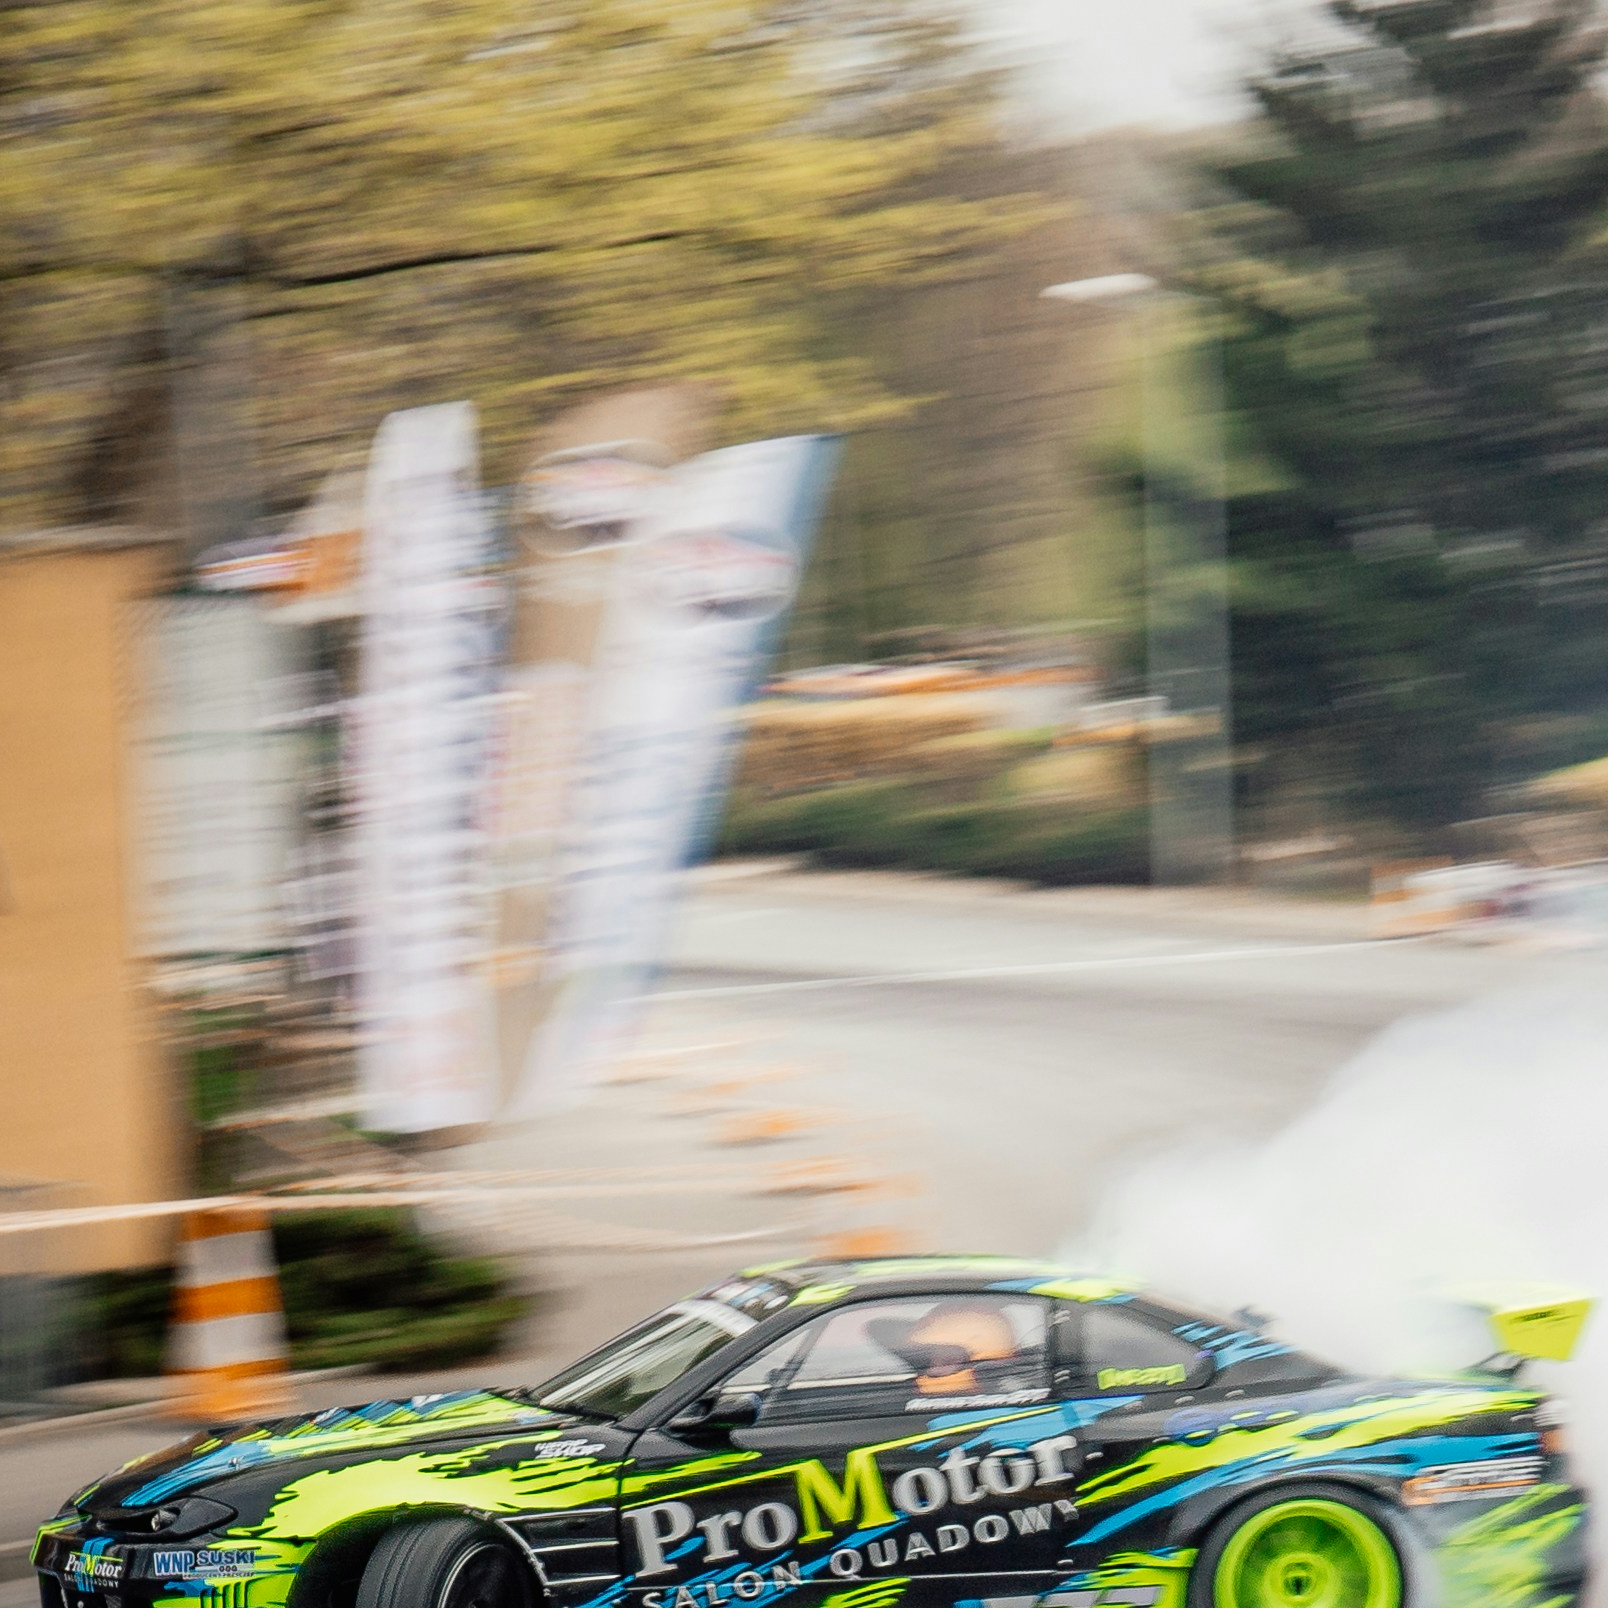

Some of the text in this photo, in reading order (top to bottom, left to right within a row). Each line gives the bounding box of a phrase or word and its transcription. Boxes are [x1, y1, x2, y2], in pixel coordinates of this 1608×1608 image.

[622, 1435, 1078, 1577] ProMotor
[64, 1553, 123, 1579] ProMotor
[155, 1550, 256, 1576] WNP SUSKI
